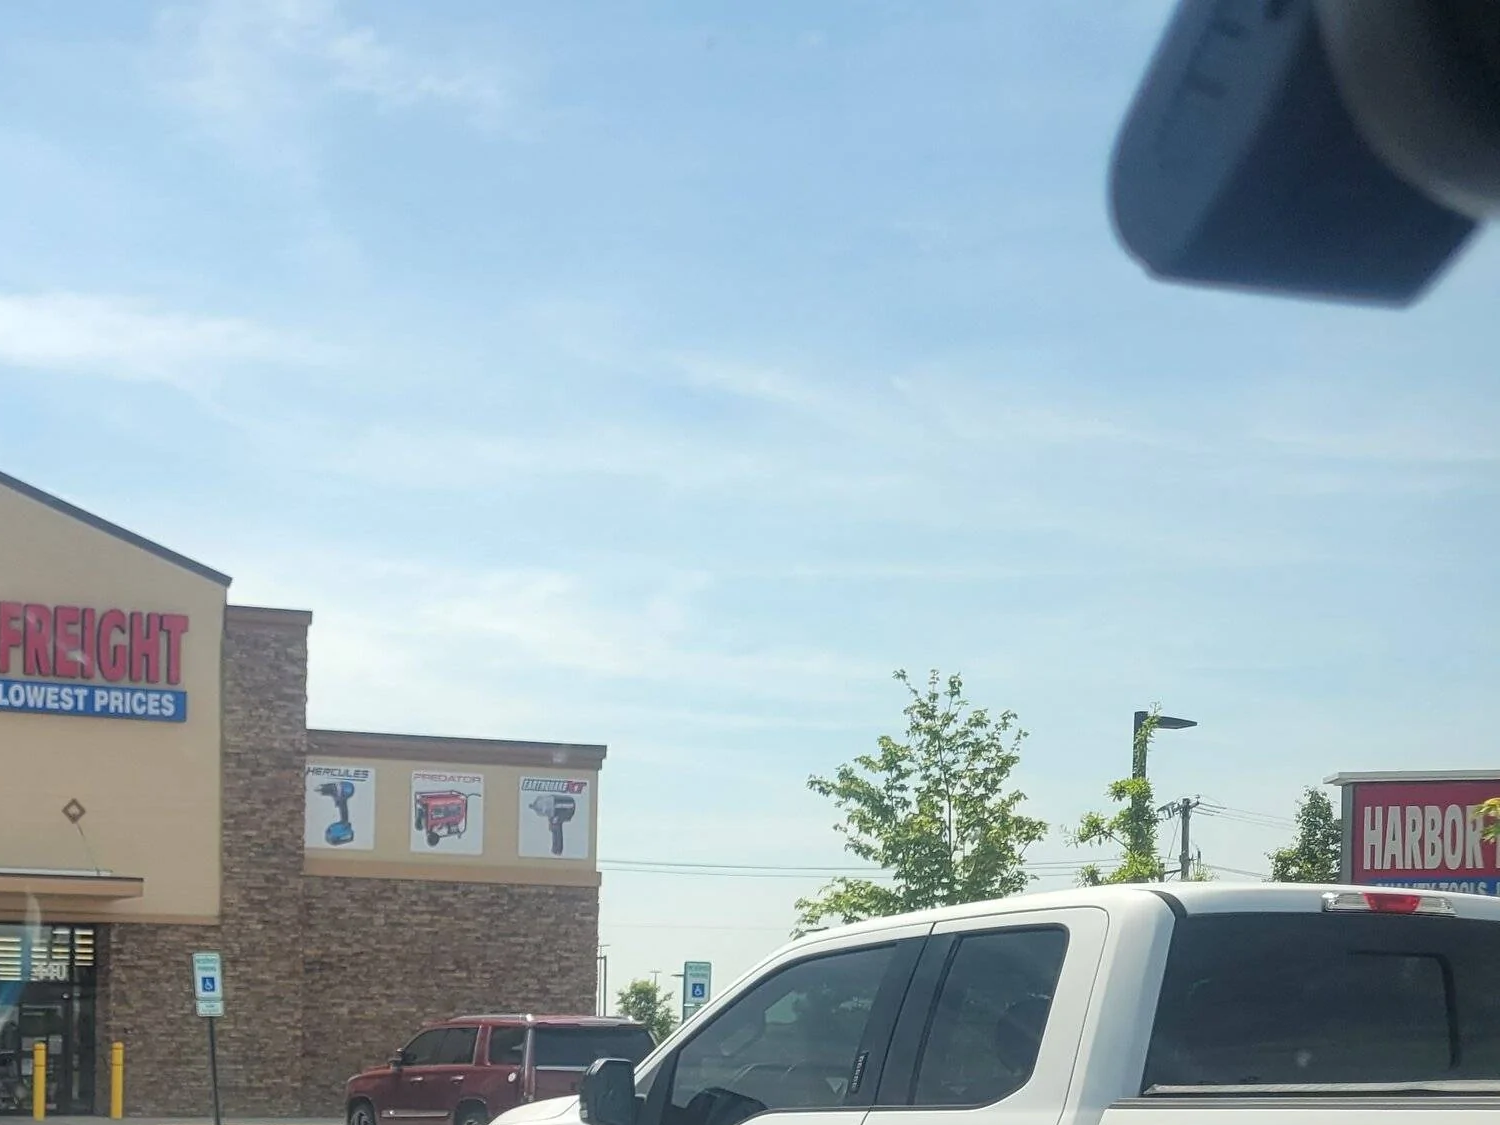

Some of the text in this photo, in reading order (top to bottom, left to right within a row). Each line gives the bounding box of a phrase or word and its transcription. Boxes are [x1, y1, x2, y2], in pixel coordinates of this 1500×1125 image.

[94, 690, 177, 717] PRICES
[306, 766, 369, 779] HERCULES
[413, 772, 482, 784] PREDATOR
[1363, 804, 1485, 871] HARBOR
